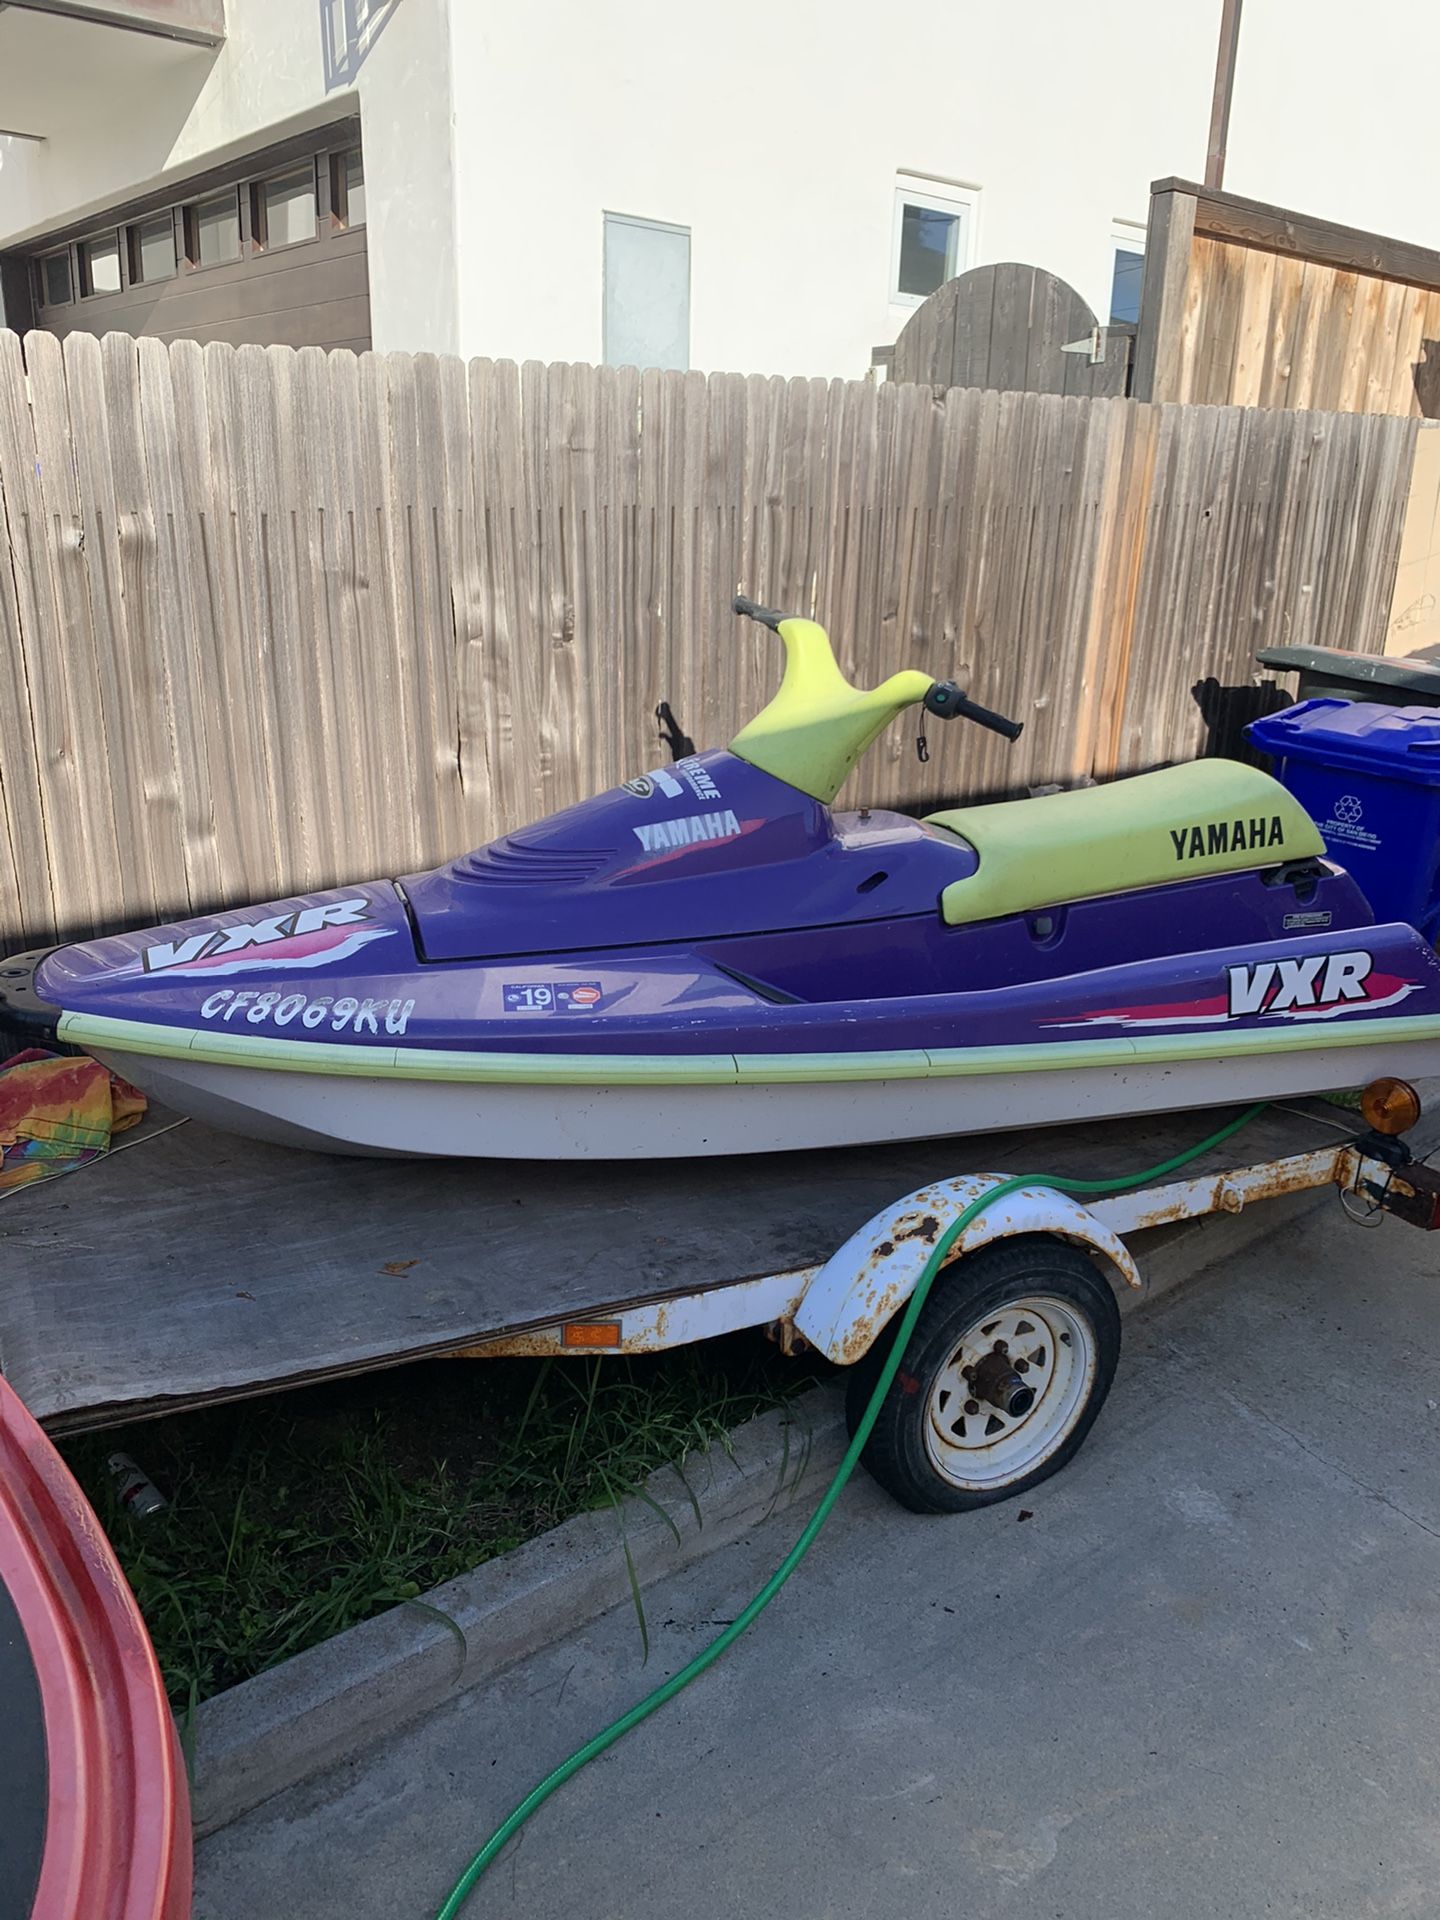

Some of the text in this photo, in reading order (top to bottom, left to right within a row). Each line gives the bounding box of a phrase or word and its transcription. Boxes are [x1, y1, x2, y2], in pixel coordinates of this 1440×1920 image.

[633, 809, 741, 851] YAMAHA
[1170, 816, 1284, 860] YAMAHA
[143, 899, 374, 973] VXR
[520, 988, 552, 1005] 19
[1228, 951, 1371, 1017] VXR
[201, 989, 415, 1035] CF8069KU
